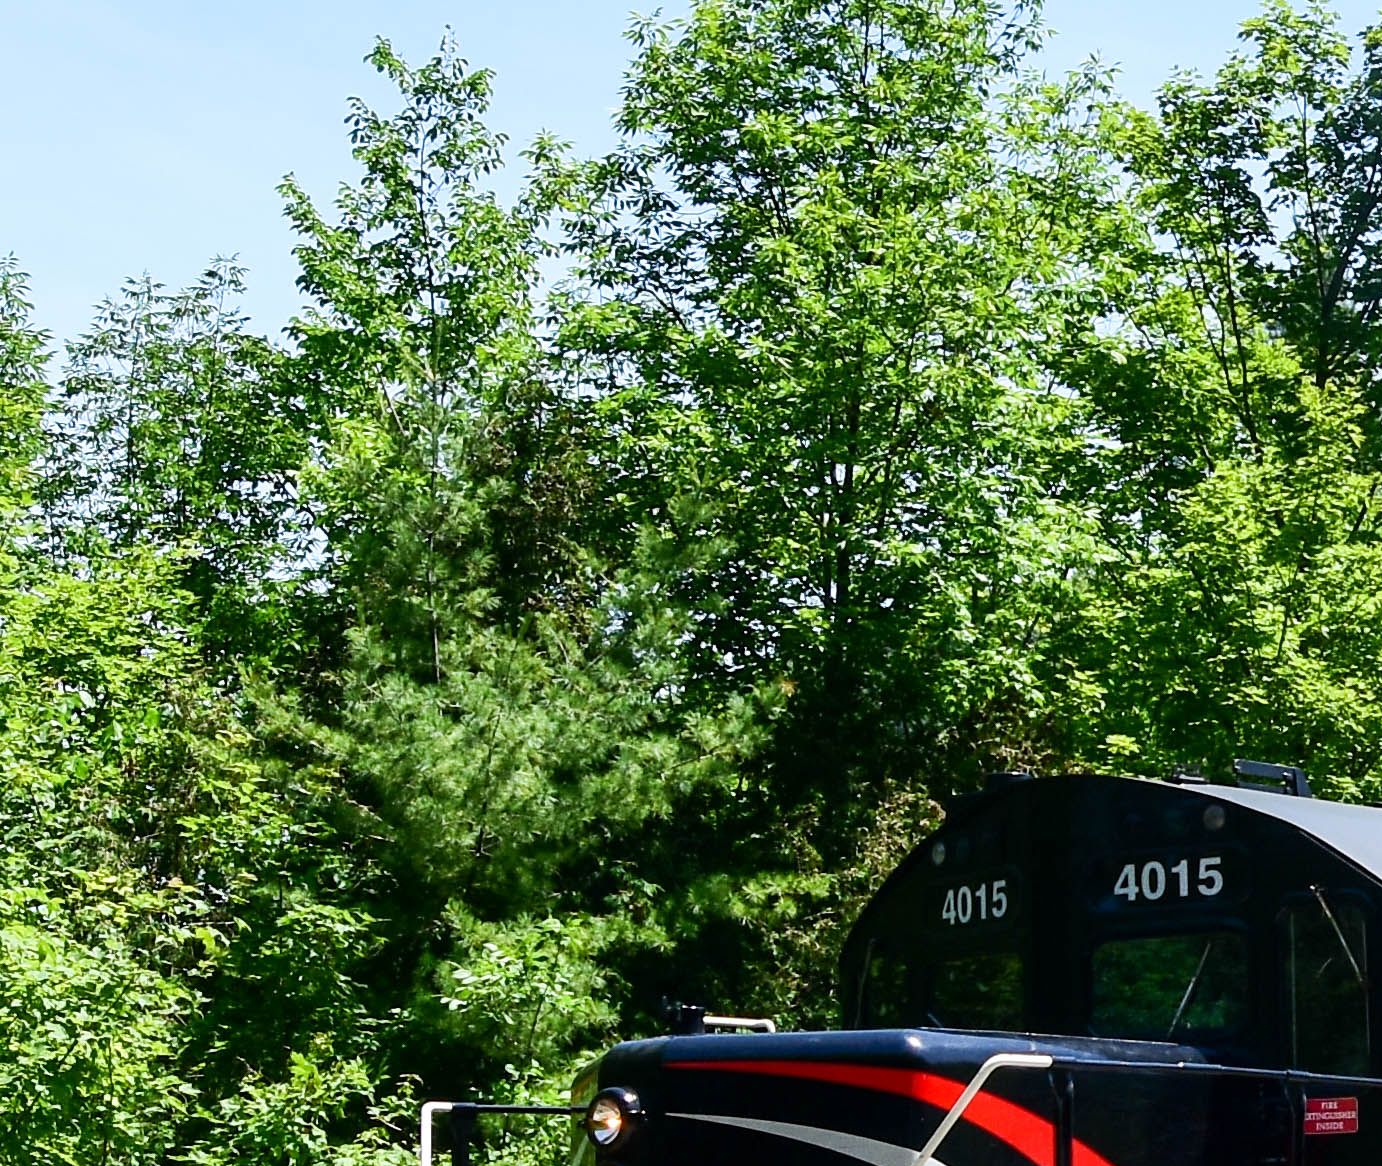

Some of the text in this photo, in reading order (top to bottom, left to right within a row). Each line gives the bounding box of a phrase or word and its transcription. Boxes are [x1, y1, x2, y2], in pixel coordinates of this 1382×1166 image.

[1114, 857, 1223, 900] 4015
[942, 880, 1007, 925] 4015
[1316, 1122, 1344, 1131] INSIDE
